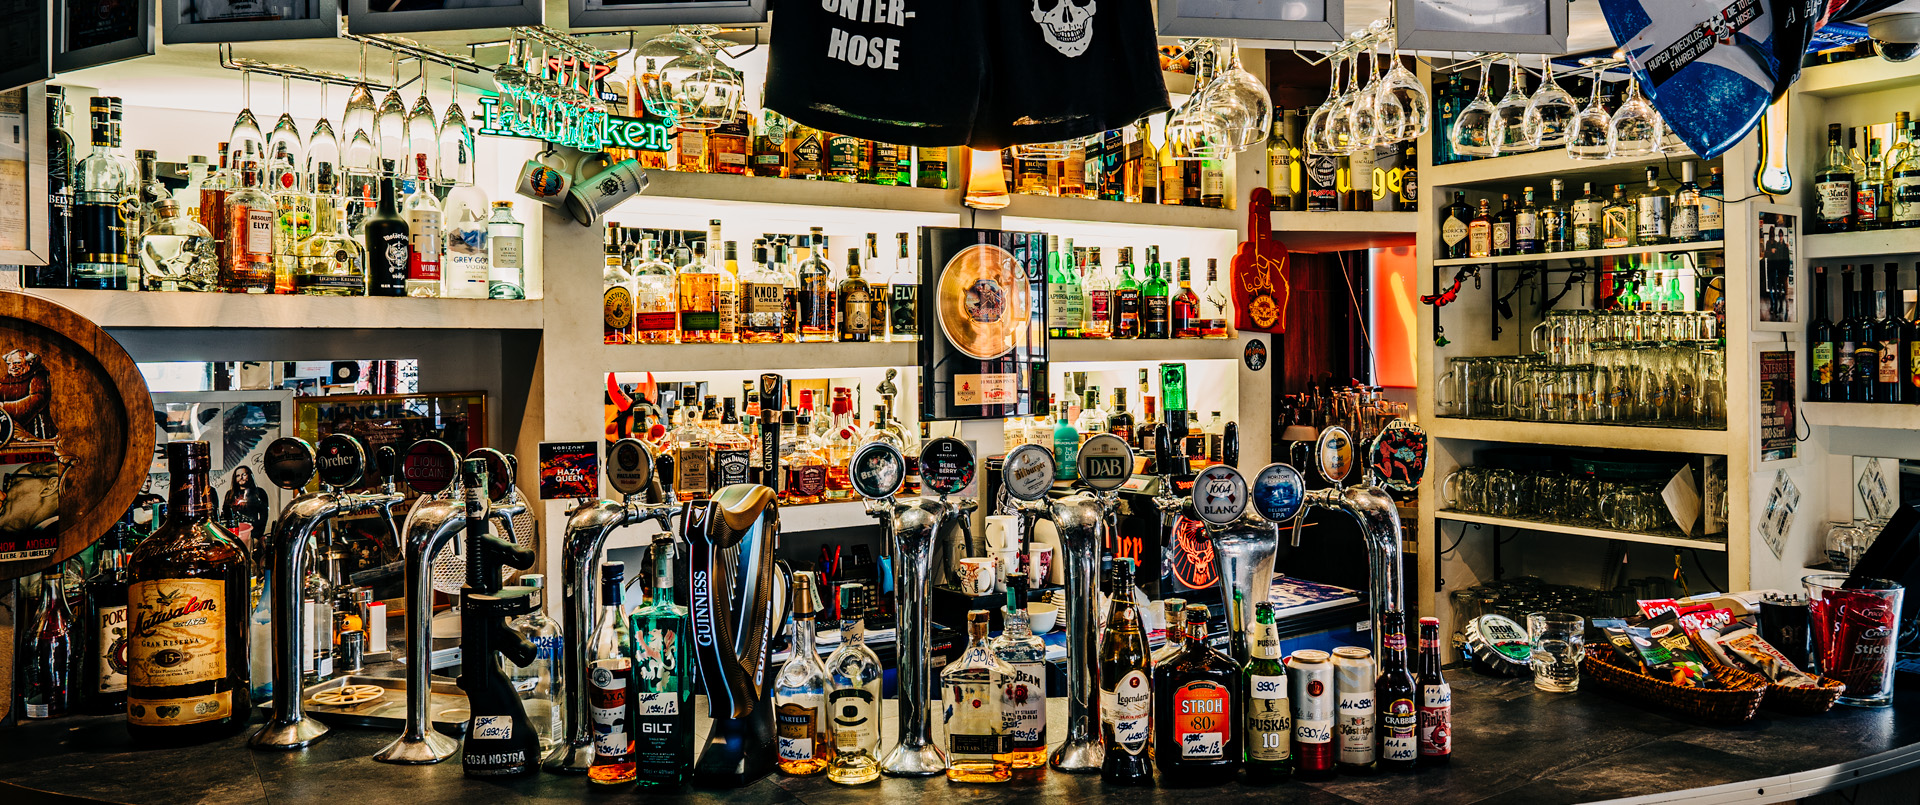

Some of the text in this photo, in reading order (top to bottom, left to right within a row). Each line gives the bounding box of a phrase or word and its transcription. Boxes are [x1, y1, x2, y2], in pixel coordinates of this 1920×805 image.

[1726, 6, 1739, 18] DIE
[1735, 8, 1757, 27] HOSEN
[828, 27, 901, 71] HOSE
[1647, 27, 1704, 71] HUPEN ZWECKLOS
[1669, 36, 1713, 71] FAHRER HÖRT
[832, 138, 859, 147] JAMESON
[253, 222, 270, 230] ELYX
[1516, 226, 1532, 235] GIN
[453, 256, 473, 264] GREY
[754, 286, 778, 298] KNOB
[764, 432, 773, 472] GUINNESS
[318, 454, 354, 469] Dreher
[1090, 458, 1122, 477] DAB
[1014, 461, 1046, 481] Bitburger
[555, 475, 584, 483] QUEEN
[1209, 483, 1233, 494] 1664
[1204, 505, 1239, 515] BLANC
[697, 570, 713, 647] GUINNESS
[1861, 608, 1884, 617] Croco
[1488, 625, 1514, 633] IRON
[1864, 628, 1891, 638] Croco
[141, 638, 200, 648] GRAN RESERVA
[1265, 646, 1275, 656] 10
[164, 653, 175, 663] 15
[1182, 698, 1223, 714] STROH
[1193, 715, 1211, 731] 80
[1262, 732, 1280, 748] 10
[466, 750, 526, 765] COSA NOSTRA
